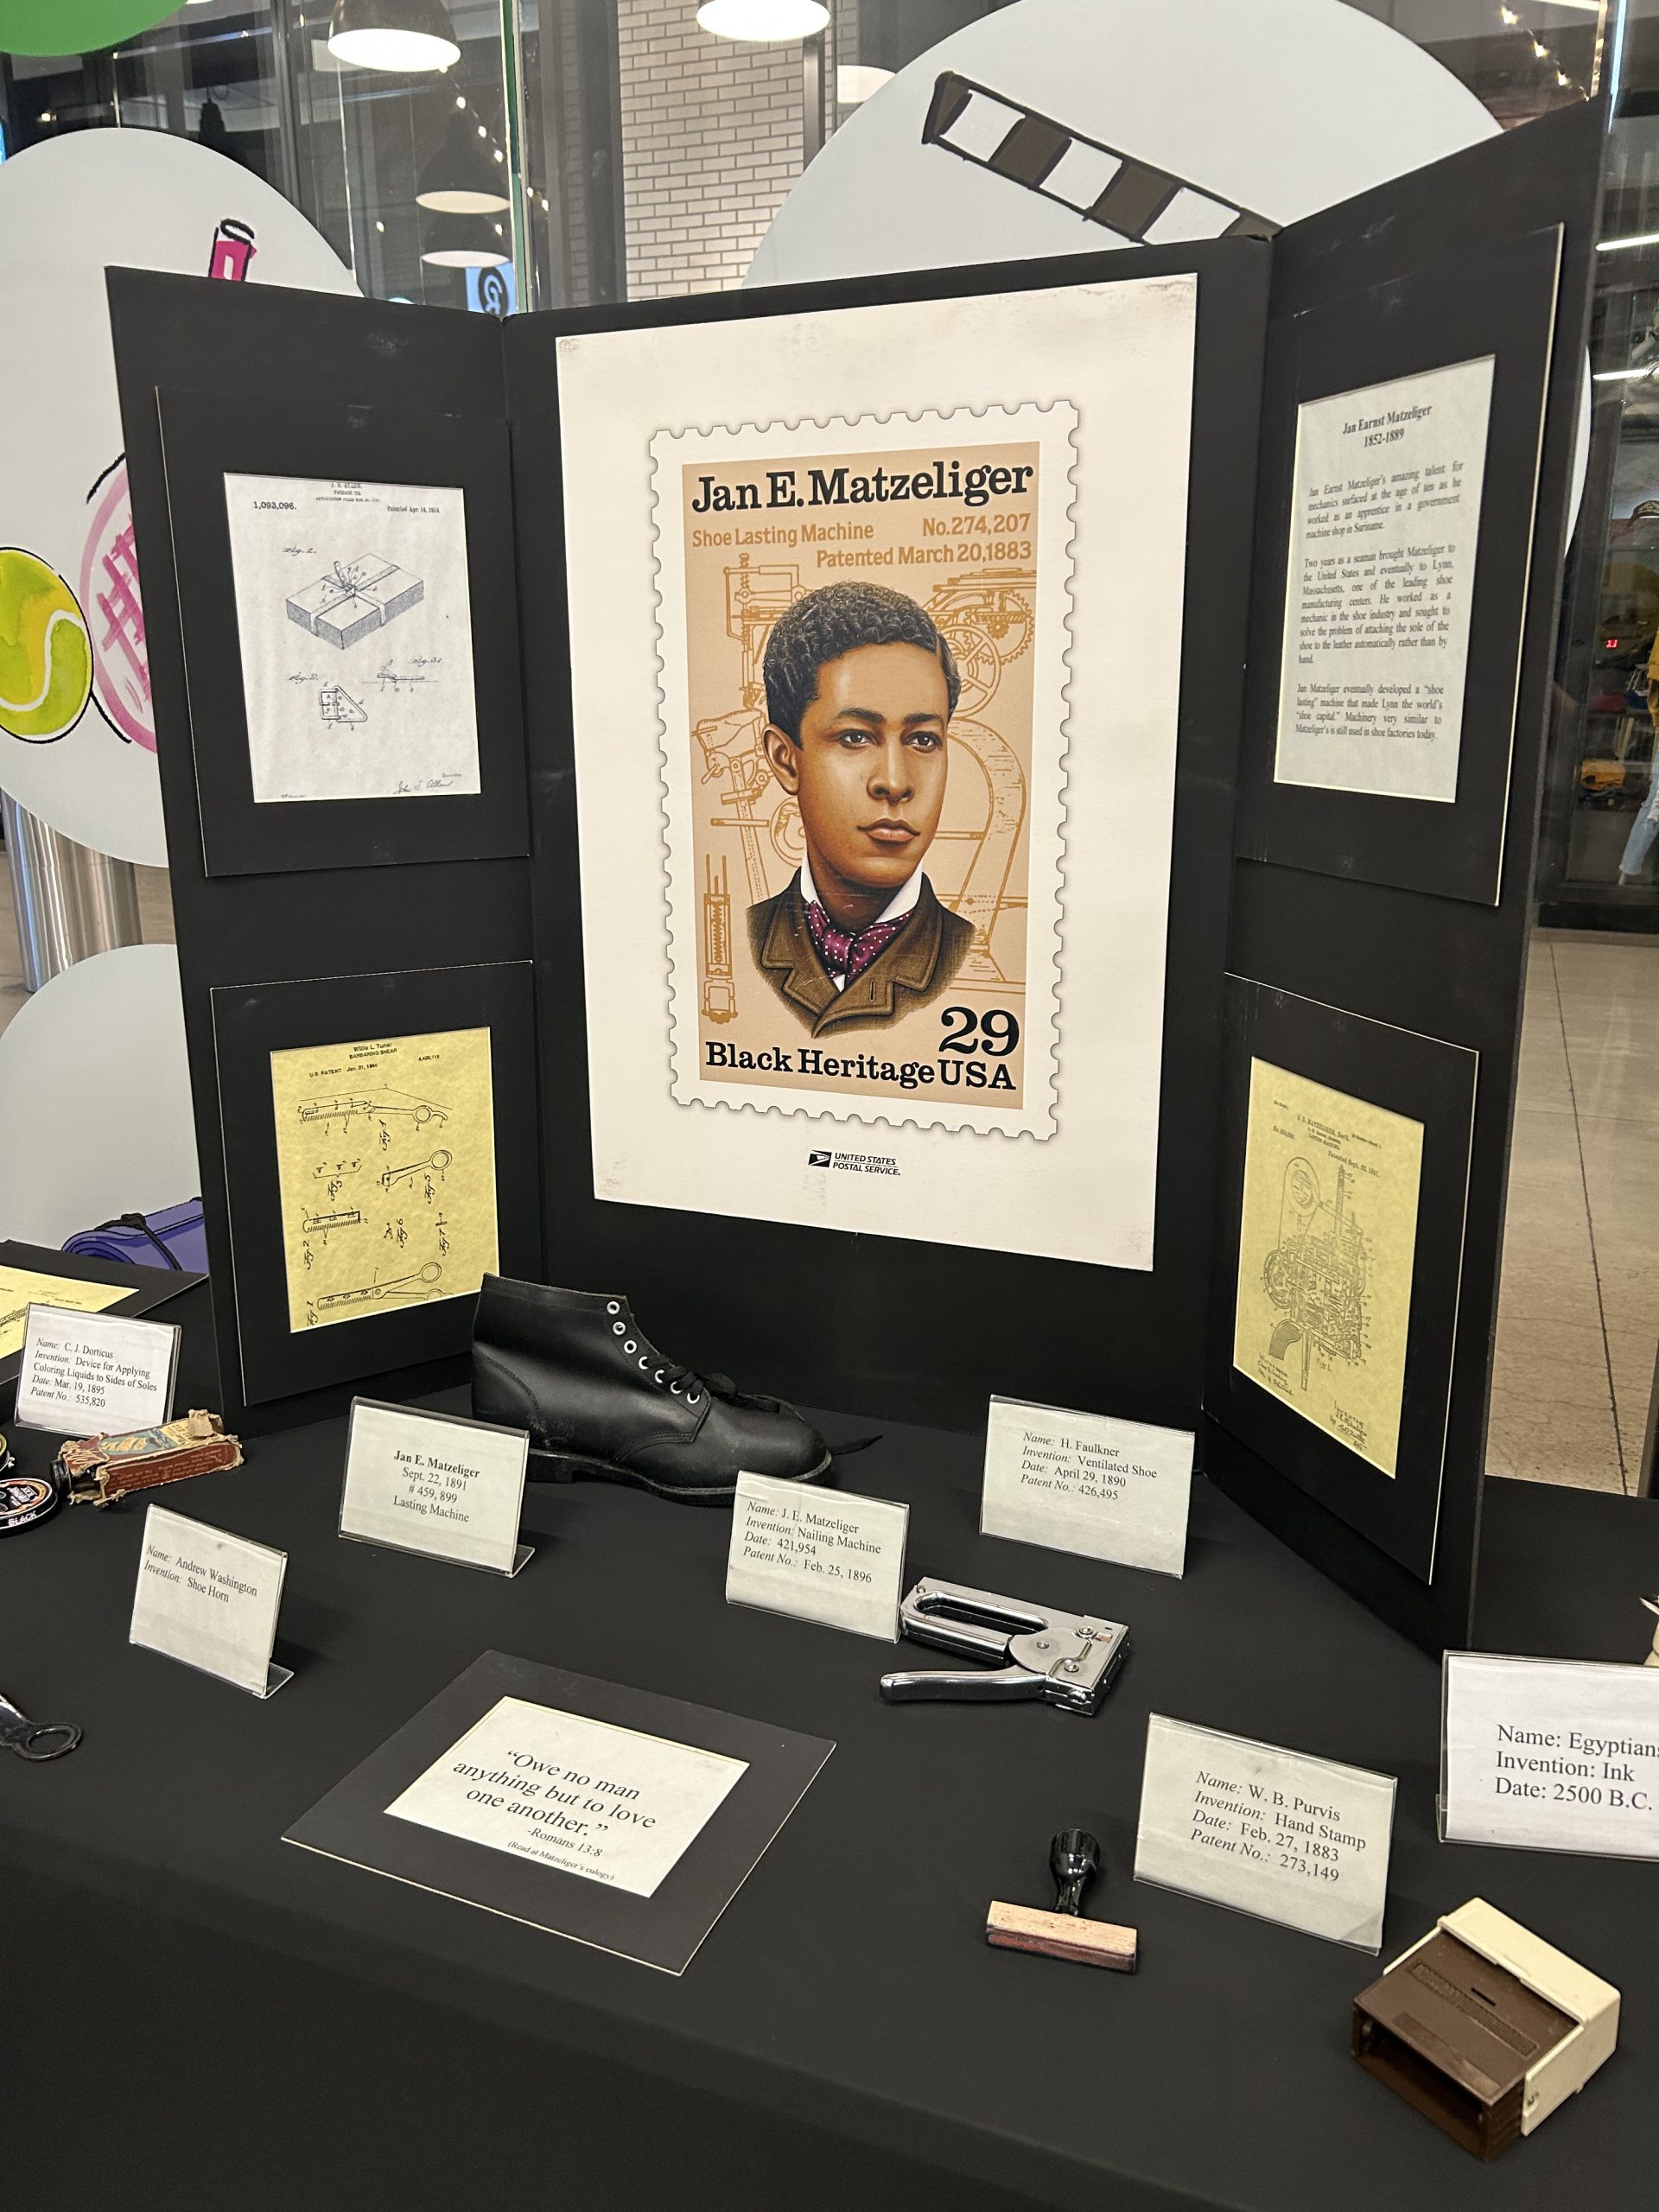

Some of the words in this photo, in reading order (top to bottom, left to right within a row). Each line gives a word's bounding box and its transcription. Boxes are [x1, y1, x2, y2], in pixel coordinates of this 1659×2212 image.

[1343, 423, 1357, 435] Jan
[1358, 416, 1385, 431] Earnst
[1386, 405, 1433, 425] Matzeliger
[1364, 428, 1404, 448] 1852-1889
[691, 476, 762, 513] Jan
[692, 530, 732, 548] Shoe
[734, 525, 798, 548] Lasting
[801, 521, 874, 543] Machine
[817, 546, 893, 568] Patented
[898, 544, 954, 564] March
[1304, 558, 1319, 569] Two
[1320, 558, 1336, 569] years
[1353, 553, 1376, 563] seaman
[1379, 548, 1404, 562] brought
[1407, 544, 1446, 557] Matzeliger
[1448, 544, 1456, 553] to
[1370, 580, 1379, 591] of
[1384, 579, 1395, 589] the
[1402, 576, 1428, 589] leading
[1436, 575, 1453, 585] shoe
[1320, 697, 1344, 707] machine
[1347, 698, 1359, 708] that
[1361, 698, 1379, 709] made
[1382, 699, 1398, 711] Lynn
[1402, 699, 1413, 709] the
[938, 1006, 1020, 1057] 29
[705, 1041, 793, 1072] Black
[798, 1048, 935, 1090] Heritage
[938, 1059, 1016, 1090] USA
[832, 1161, 863, 1172] POSTAL
[835, 1153, 866, 1163] UNITED
[867, 1156, 896, 1166] STATES
[36, 1338, 60, 1350] Name:
[64, 1342, 73, 1352] C.
[74, 1344, 81, 1354] J.
[82, 1344, 113, 1359] Dorticus
[33, 1362, 65, 1377] Coloring
[67, 1368, 94, 1381] Liquids
[96, 1374, 104, 1382] to
[105, 1374, 125, 1386] Sides
[127, 1379, 137, 1388] of
[137, 1380, 157, 1392] Soles
[35, 1350, 71, 1363] Invention:
[75, 1357, 101, 1370] Device
[102, 1361, 114, 1371] for
[115, 1364, 150, 1380] Applying
[30, 1386, 54, 1398] Patent
[55, 1391, 70, 1401] No.:
[75, 1395, 105, 1408] 535,820
[31, 1374, 52, 1386] Date:
[54, 1378, 72, 1389] Mar.
[74, 1382, 85, 1393] 19,
[87, 1384, 105, 1395] 1895
[1023, 1432, 1054, 1446] Name:
[1061, 1438, 1072, 1449] H.
[1076, 1440, 1120, 1457] Faulkner
[394, 1450, 412, 1463] Jan
[415, 1454, 424, 1466] E.
[427, 1457, 480, 1478] Matzeliger
[1021, 1459, 1048, 1473] Date:
[1054, 1466, 1079, 1479] April
[1083, 1471, 1098, 1484] 29,
[1103, 1474, 1126, 1487] 1890
[1023, 1446, 1071, 1463] Invention:
[1077, 1455, 1128, 1473] Ventilated
[1132, 1465, 1157, 1478] Shoe
[402, 1467, 425, 1483] Sept.
[428, 1472, 442, 1486] 22,
[446, 1477, 467, 1491] 1891
[1020, 1474, 1052, 1488] Patent
[1054, 1480, 1075, 1492] No.:
[1078, 1484, 1118, 1500] 426,495
[409, 1484, 415, 1493] #
[416, 1486, 437, 1501] 459,
[440, 1491, 458, 1503] 899
[8, 1510, 37, 1526] BLACK
[393, 1495, 427, 1515] Lasting
[429, 1503, 469, 1522] Machine
[747, 1501, 779, 1516] Name:
[781, 1508, 789, 1519] J.
[792, 1510, 802, 1522] E.
[805, 1513, 859, 1534] Matzeliger
[744, 1531, 772, 1546] Date:
[778, 1538, 816, 1555] 421,954
[746, 1516, 795, 1535] Invention:
[798, 1527, 834, 1547] Nailing
[836, 1535, 881, 1554] Machine
[146, 1544, 172, 1562] Name:
[175, 1556, 207, 1576] Andrew
[209, 1568, 257, 1597] Washington
[743, 1546, 775, 1561] Patent
[776, 1553, 798, 1567] No.:
[804, 1559, 824, 1573] Feb.
[828, 1564, 843, 1579] 25,
[849, 1568, 872, 1583] 1896
[143, 1560, 182, 1584] Invention:
[187, 1577, 207, 1593] Shoe
[207, 1585, 229, 1603] Horn
[1497, 1724, 1560, 1747] Name:
[1569, 1732, 1659, 1758] Egyptian
[1497, 1751, 1595, 1777] Invention:
[1603, 1762, 1635, 1782] Ink
[453, 1763, 542, 1796] anything
[544, 1785, 580, 1805] but
[582, 1799, 604, 1812] to
[608, 1804, 656, 1828] love
[466, 1790, 505, 1808] one
[563, 1771, 590, 1785] no
[594, 1781, 639, 1800] man
[1196, 1771, 1243, 1794] Name:
[1249, 1783, 1268, 1802] W.
[1273, 1791, 1287, 1808] B.
[1294, 1797, 1340, 1821] Purvis
[1496, 1777, 1546, 1799] Date:
[1553, 1783, 1602, 1804] 2500
[1609, 1789, 1652, 1811] B.C.
[1192, 1809, 1231, 1831] Date:
[1240, 1821, 1270, 1843] Feb.
[1275, 1833, 1298, 1853] 27,
[1305, 1840, 1338, 1861] 1883
[1194, 1790, 1266, 1821] Invention:
[1274, 1812, 1314, 1834] Hand
[1319, 1825, 1366, 1852] Stamp
[577, 1843, 603, 1857] 13:8
[1191, 1828, 1236, 1852] Patent
[1239, 1842, 1270, 1862] No.:
[1280, 1853, 1339, 1882] 273,149
